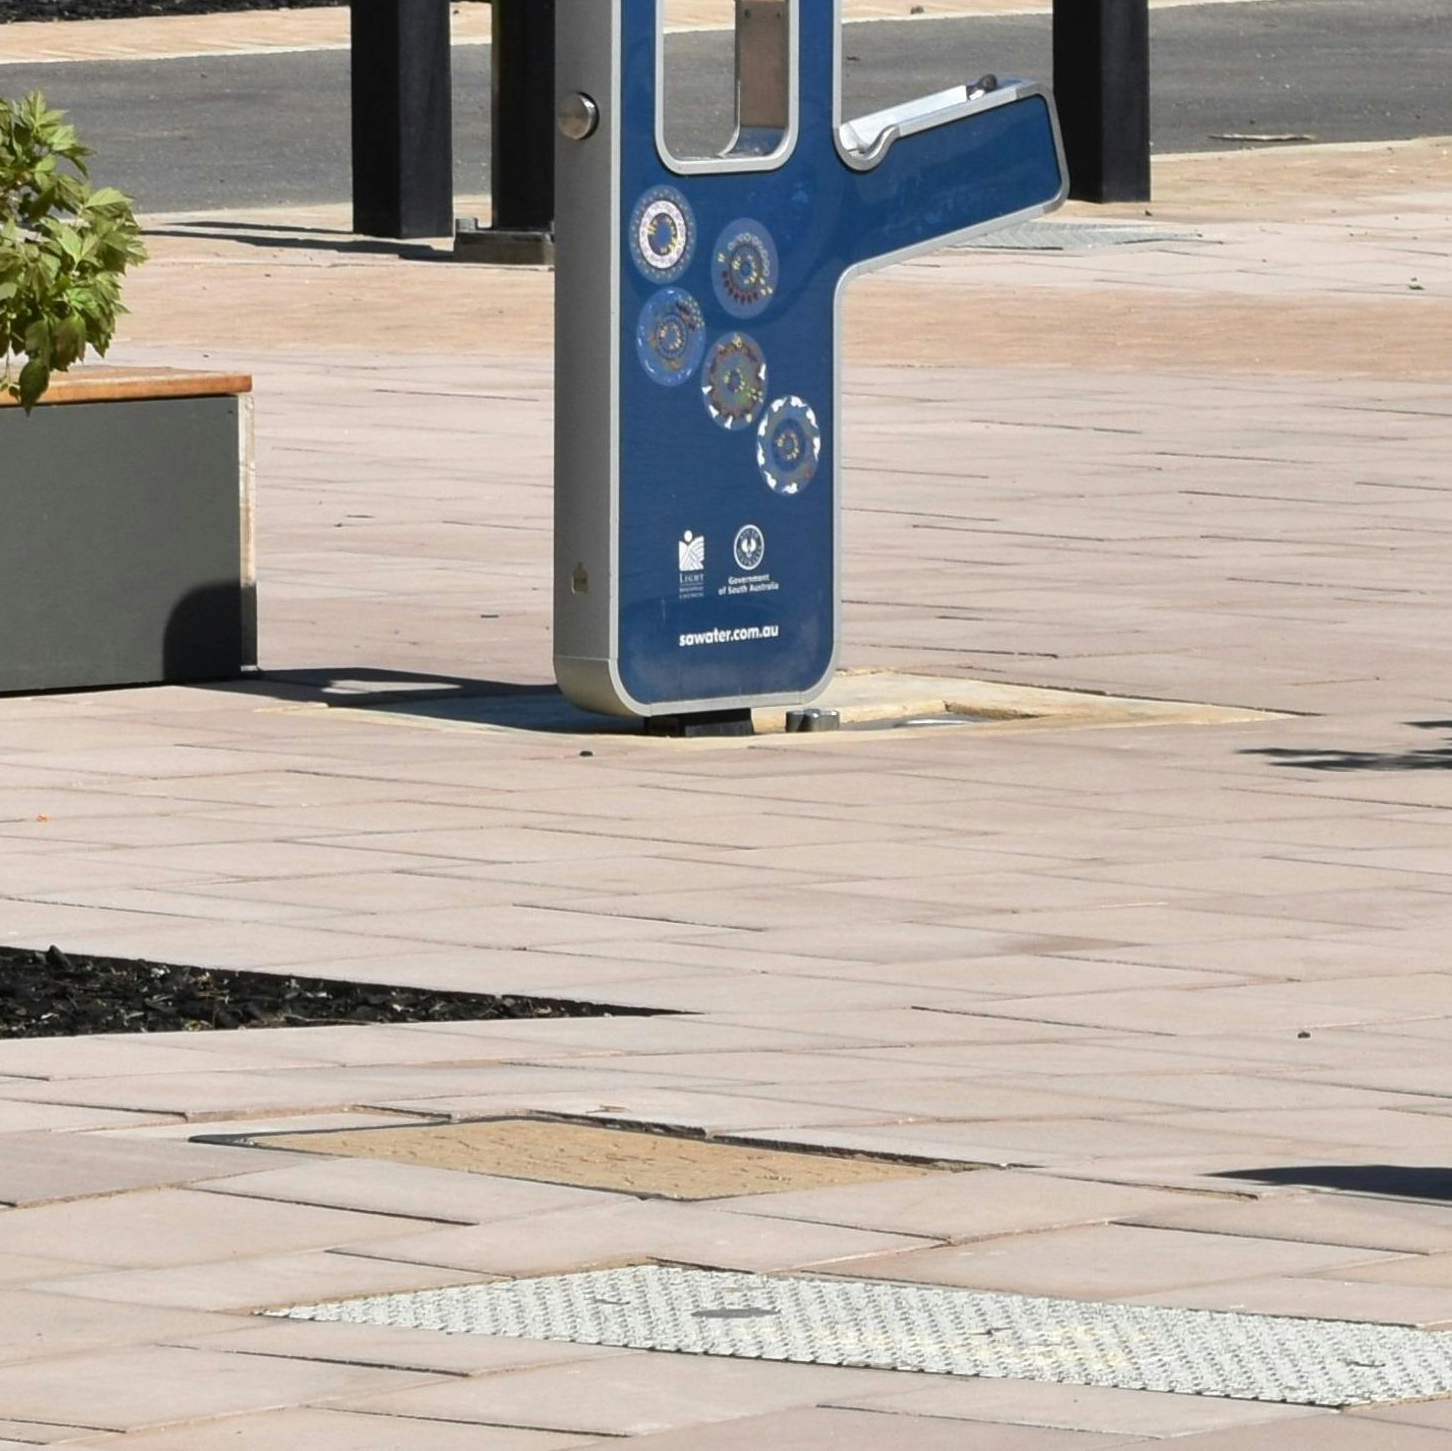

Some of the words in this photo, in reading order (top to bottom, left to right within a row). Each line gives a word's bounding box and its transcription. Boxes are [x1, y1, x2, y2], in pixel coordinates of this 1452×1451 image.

[728, 574, 770, 586] Government
[718, 586, 726, 596] of
[728, 584, 748, 596] South
[749, 581, 779, 593] Australia
[679, 625, 779, 647] sawater.com.au
